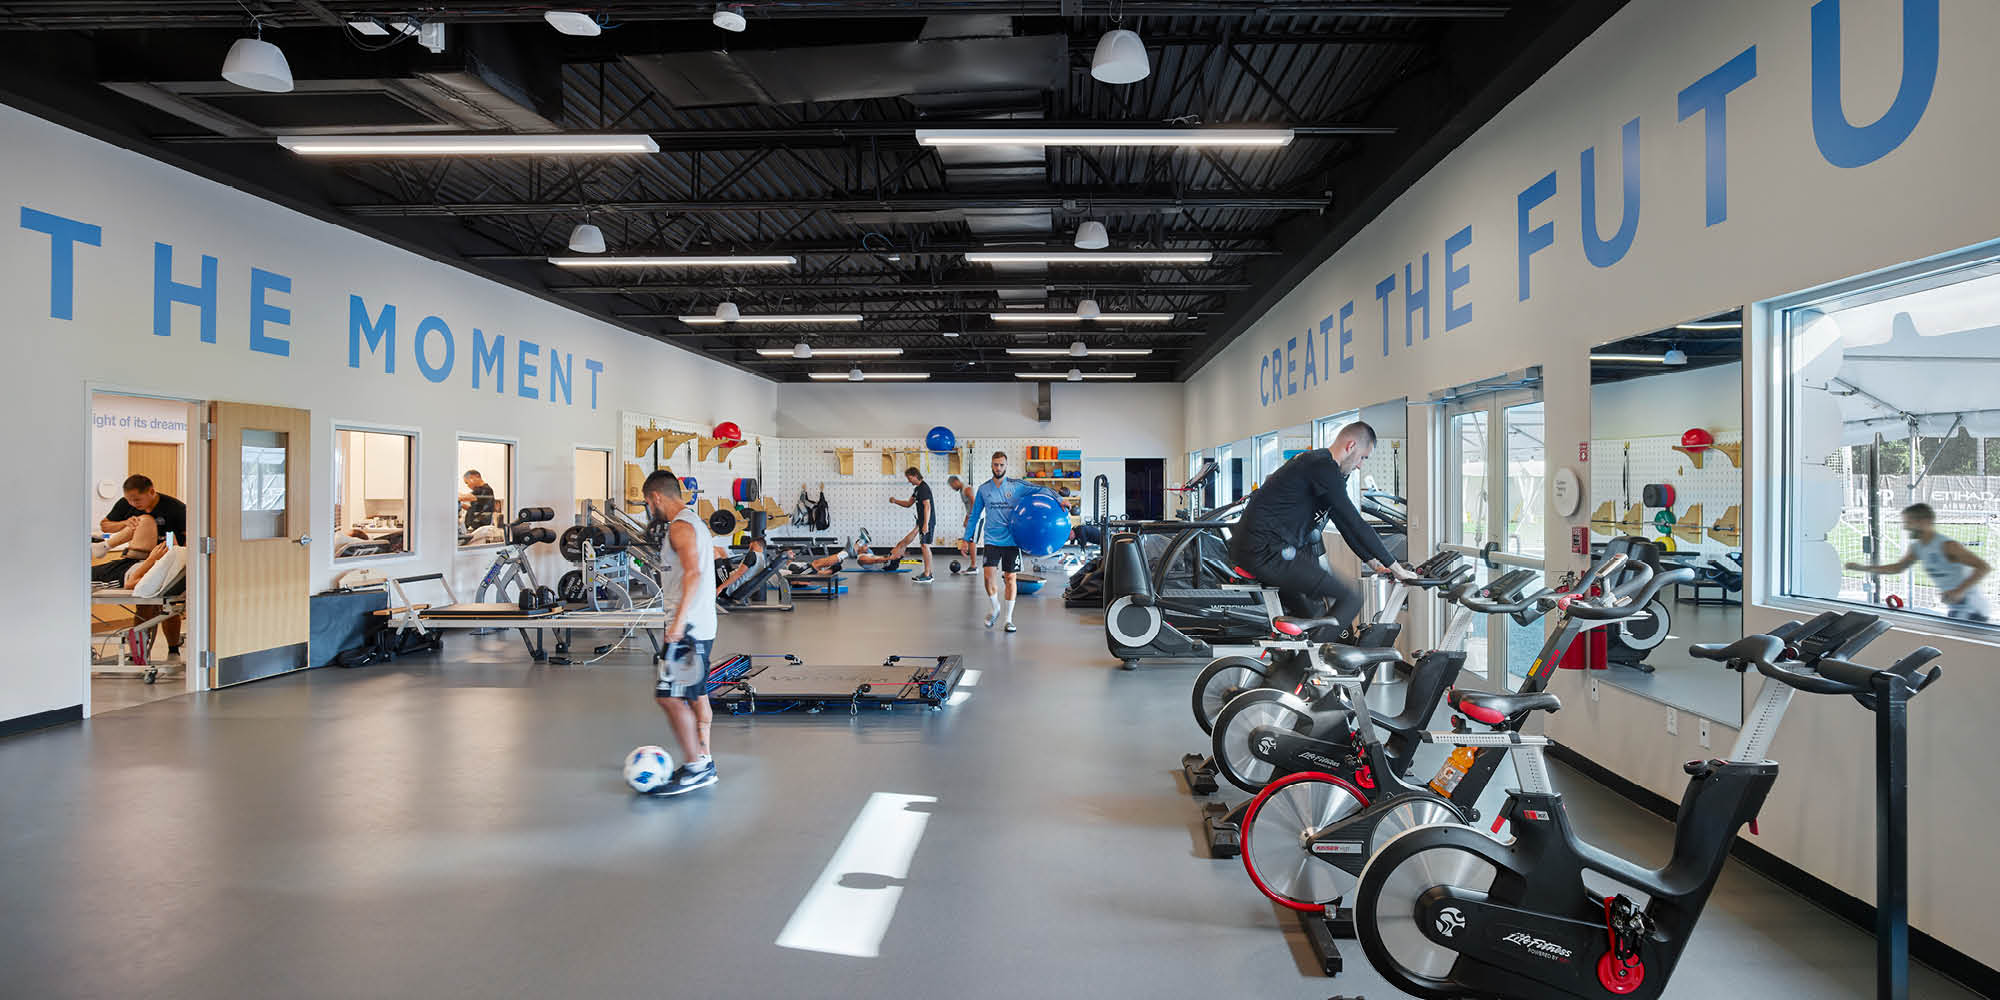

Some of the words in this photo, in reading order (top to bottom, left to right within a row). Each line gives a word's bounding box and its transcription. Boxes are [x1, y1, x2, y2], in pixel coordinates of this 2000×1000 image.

[1260, 301, 1354, 407] CREATE
[1376, 224, 1473, 356] THE
[1518, 0, 1940, 302] FUTU
[20, 206, 292, 357] THE
[349, 294, 604, 409] MOMENT
[119, 416, 131, 427] of
[133, 416, 147, 429] its
[1931, 490, 1995, 501] ETIHAD
[1527, 947, 1552, 959] POWERED
